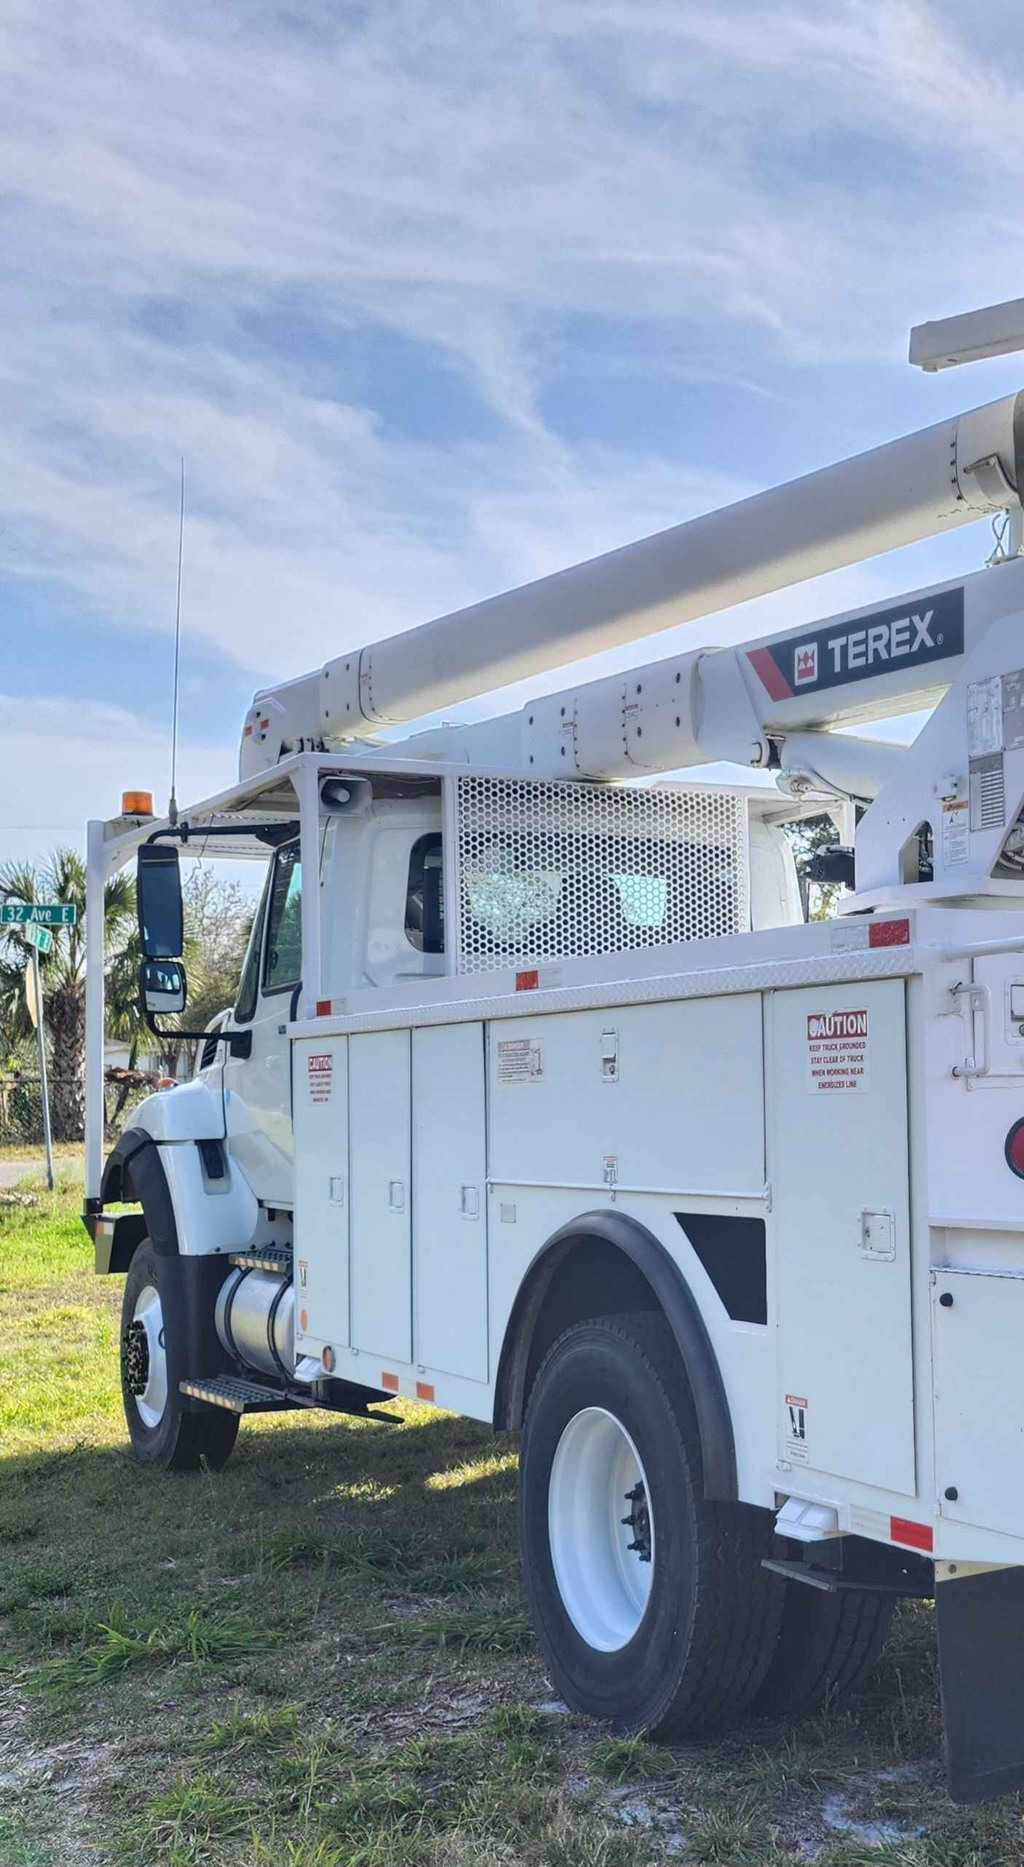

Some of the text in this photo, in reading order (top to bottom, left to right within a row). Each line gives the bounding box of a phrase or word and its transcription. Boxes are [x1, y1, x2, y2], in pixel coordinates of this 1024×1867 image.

[827, 609, 936, 673] TEREX
[7, 906, 69, 922] 32 Ave E
[809, 1014, 867, 1037] CAUTION
[822, 1043, 838, 1051] TRUCK
[839, 1042, 866, 1050] GROUNDED
[823, 1056, 838, 1064] CLEAR
[826, 1068, 849, 1076] WORKING
[850, 1067, 864, 1075] NEAR
